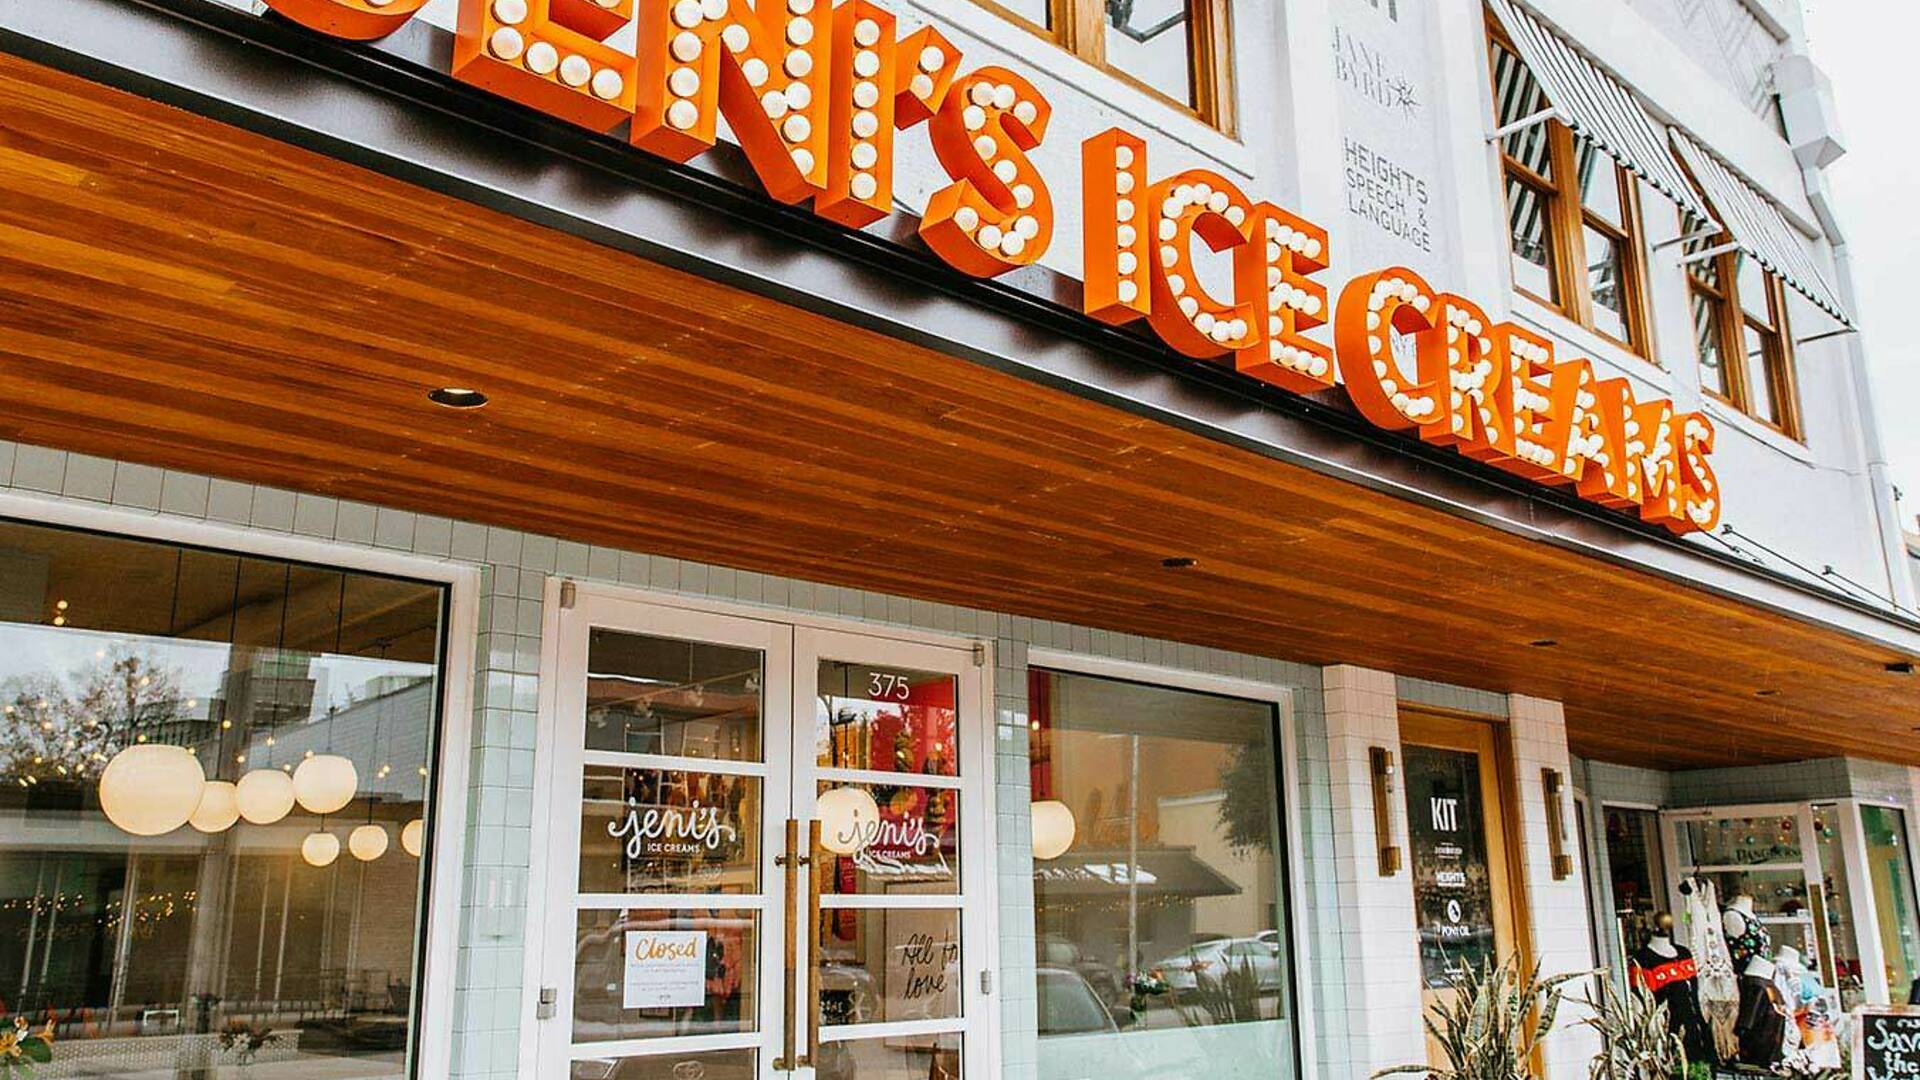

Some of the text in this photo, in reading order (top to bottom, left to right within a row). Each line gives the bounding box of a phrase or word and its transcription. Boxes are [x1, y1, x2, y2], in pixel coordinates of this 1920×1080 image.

[1344, 137, 1429, 206] HEIGHTS
[1346, 168, 1429, 228] SPEECH &
[1348, 192, 1431, 253] LANGUAGE
[263, 0, 1721, 537] NI'S ICE CREAMS
[867, 671, 911, 701] 375
[608, 796, 736, 859] jeni's
[1430, 797, 1459, 832] KIT
[647, 843, 701, 854] ICE CREAMS
[881, 849, 912, 860] CREAMS
[635, 937, 698, 961] Closed
[903, 967, 948, 1000] love
[1883, 1051, 1919, 1073] the
